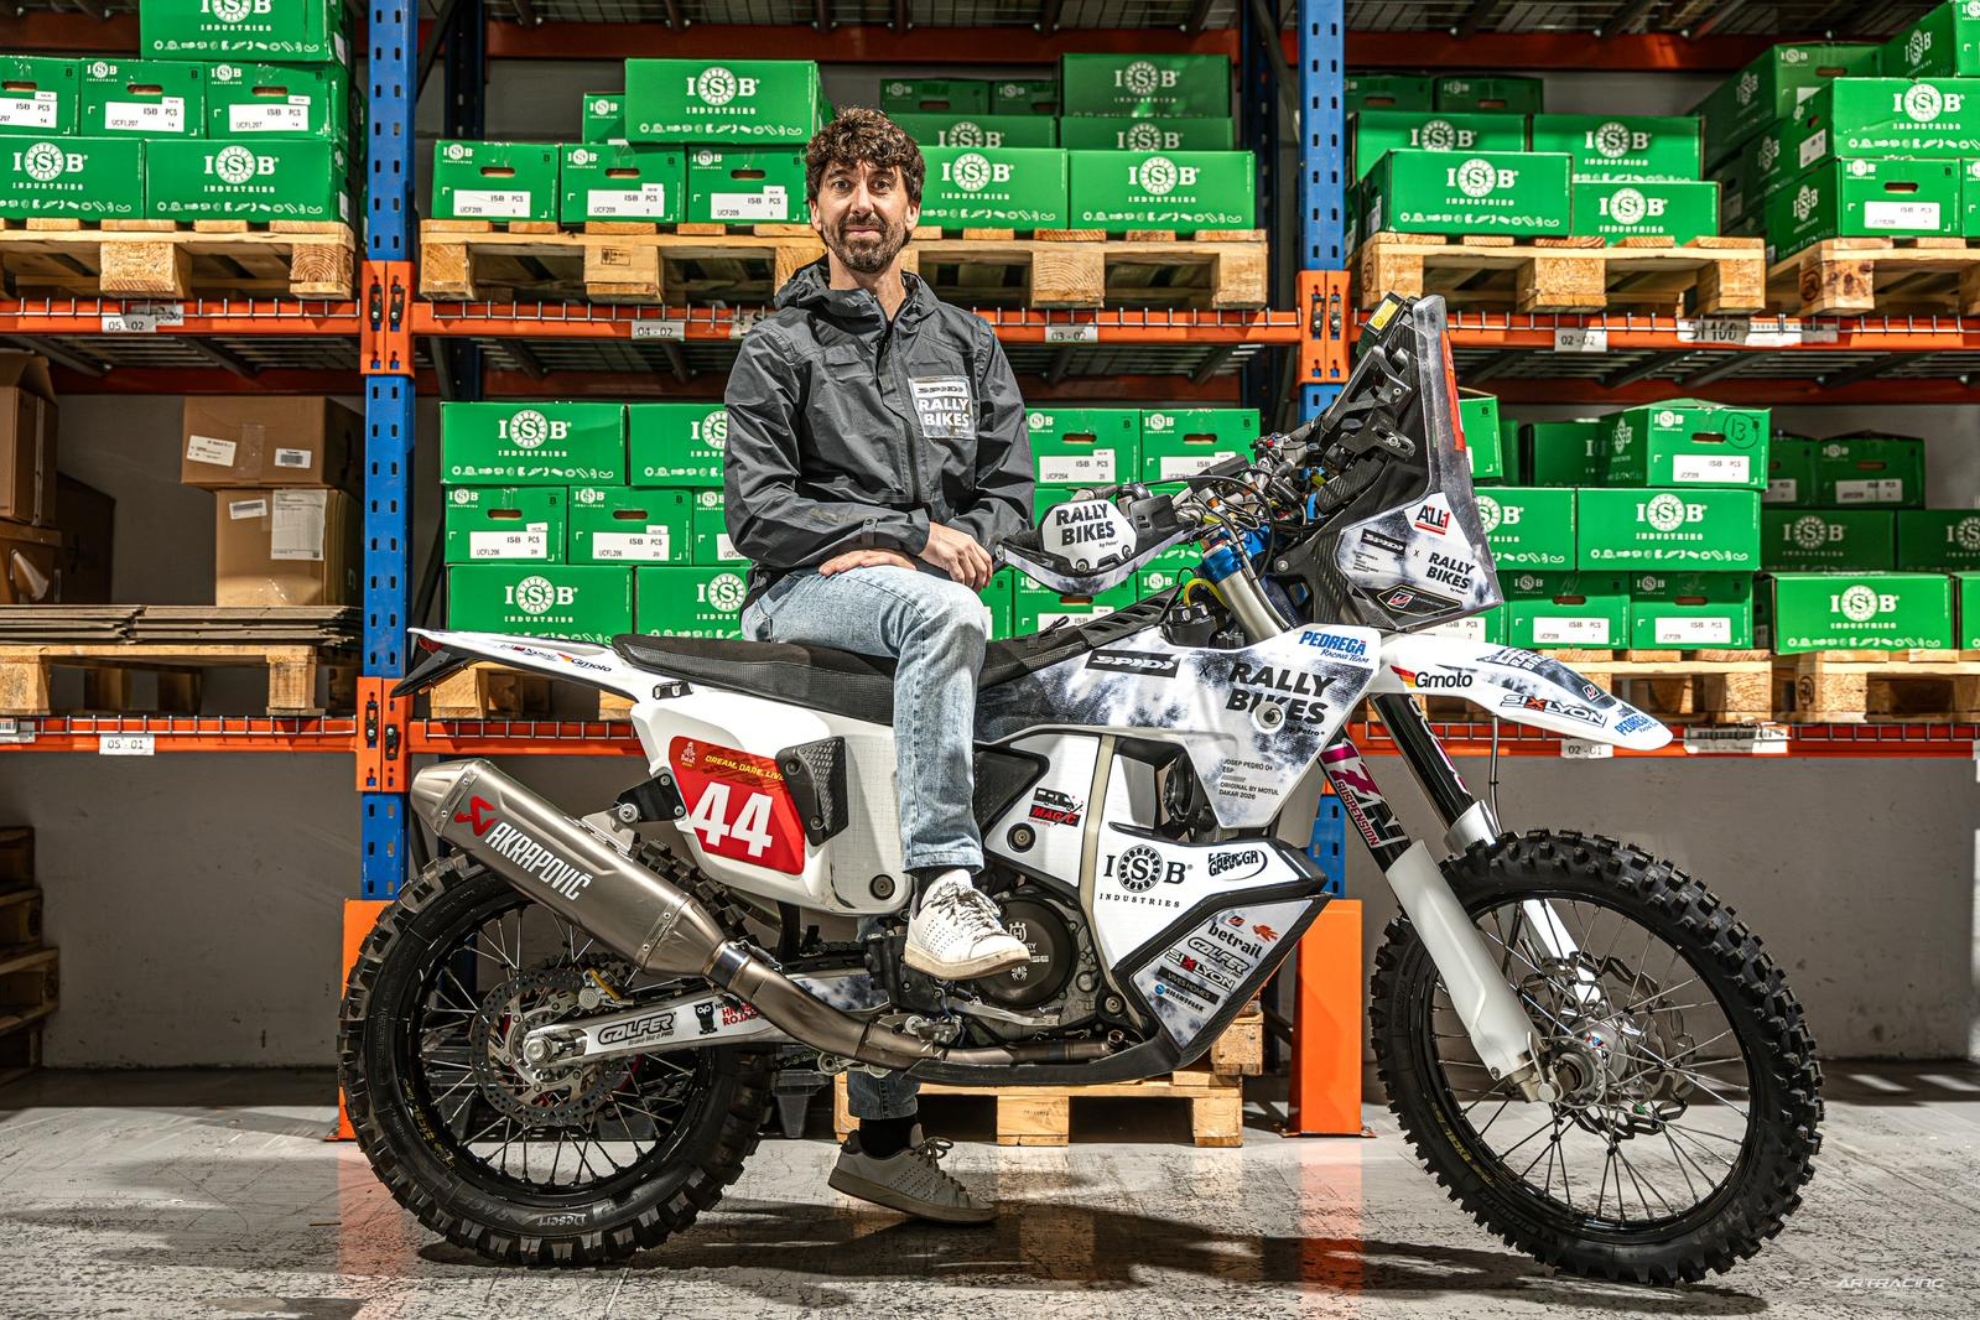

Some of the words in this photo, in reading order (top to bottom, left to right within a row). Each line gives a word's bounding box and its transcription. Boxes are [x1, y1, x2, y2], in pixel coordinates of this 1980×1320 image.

[86, 63, 118, 77] ISB
[211, 65, 242, 80] ISB
[1114, 64, 1176, 91] ISB
[686, 70, 755, 102] ISB
[38, 104, 51, 112] PCS
[590, 100, 618, 114] ISB
[686, 107, 756, 115] INDUSTRIES
[1893, 87, 1961, 119] ISB
[143, 108, 158, 116] ISB
[165, 109, 178, 117] PCS
[267, 109, 282, 117] ISB
[288, 109, 302, 117] PCS
[939, 123, 1001, 146] ISB
[1117, 125, 1180, 149] ISB
[1411, 123, 1473, 148] ISB
[1585, 125, 1648, 154] ISB
[443, 145, 473, 158] ISB
[568, 150, 597, 164] ISB
[693, 152, 722, 166] ISB
[13, 145, 84, 178] ISB
[204, 148, 275, 181] ISB
[942, 156, 1010, 189] ISB
[1128, 160, 1196, 192] ISB
[1446, 162, 1515, 195] ISB
[12, 182, 84, 191] INDUSTRIES
[491, 195, 505, 203] ISB
[512, 195, 524, 203] PCS
[624, 194, 639, 203] ISB
[645, 195, 658, 203] PCS
[747, 197, 762, 205] ISB
[769, 197, 781, 206] PCS
[1446, 198, 1515, 206] INDUSTRIES
[1600, 191, 1665, 222] ISB
[1600, 225, 1665, 233] INDUSTRIES
[108, 321, 121, 331] 05
[131, 321, 144, 331] 02
[638, 327, 650, 337] 04
[660, 328, 673, 338] 02
[1052, 331, 1067, 342] 03
[1561, 336, 1573, 346] 02
[1582, 336, 1595, 346] 02
[918, 398, 969, 412] RALLY
[924, 411, 970, 428] BIKES
[499, 413, 567, 446] ISB
[449, 490, 478, 503] ISB
[575, 489, 604, 503] ISB
[1055, 504, 1109, 527] RALLY
[1636, 497, 1704, 529] ISB
[506, 536, 521, 544] ISB
[528, 536, 540, 544] PCS
[1061, 521, 1116, 546] BIKES
[1636, 533, 1703, 541] INDUSTRIES
[1784, 519, 1843, 546] ISB
[650, 538, 663, 546] PCS
[1428, 552, 1476, 576] RALLY
[1426, 566, 1472, 590] BIKES
[1514, 576, 1544, 591] ISB
[1637, 577, 1665, 591] ISB
[505, 579, 573, 612] ISB
[1830, 588, 1897, 618] ISB
[570, 656, 613, 673] Gmoto
[1092, 654, 1179, 673] SPIDI
[1228, 662, 1337, 698] RALLY
[1415, 672, 1473, 689] Gmoto
[1500, 694, 1608, 728] SIXLYON
[108, 738, 121, 750] 05
[131, 738, 144, 750] 01
[1568, 745, 1581, 754] 02
[1590, 745, 1602, 754] 01
[704, 754, 738, 770] DREAM.
[739, 762, 764, 778] DARE.
[1222, 758, 1243, 767] JOSEP
[1219, 782, 1248, 791] ORIGINAL
[1258, 786, 1279, 796] MOTUL
[1219, 789, 1237, 798] DAKAR
[687, 780, 775, 859] 44
[1335, 779, 1381, 849] SUSPENSION
[485, 821, 594, 901] AKRAPOVIČ
[1103, 847, 1186, 890] ISB
[1099, 893, 1181, 908] INDUSTRIES
[1208, 922, 1263, 960] betrail
[1188, 937, 1252, 975] GALFER
[1164, 949, 1236, 990] SIXLYON
[598, 1012, 673, 1046] GALFER
[536, 1215, 587, 1228] Desert
